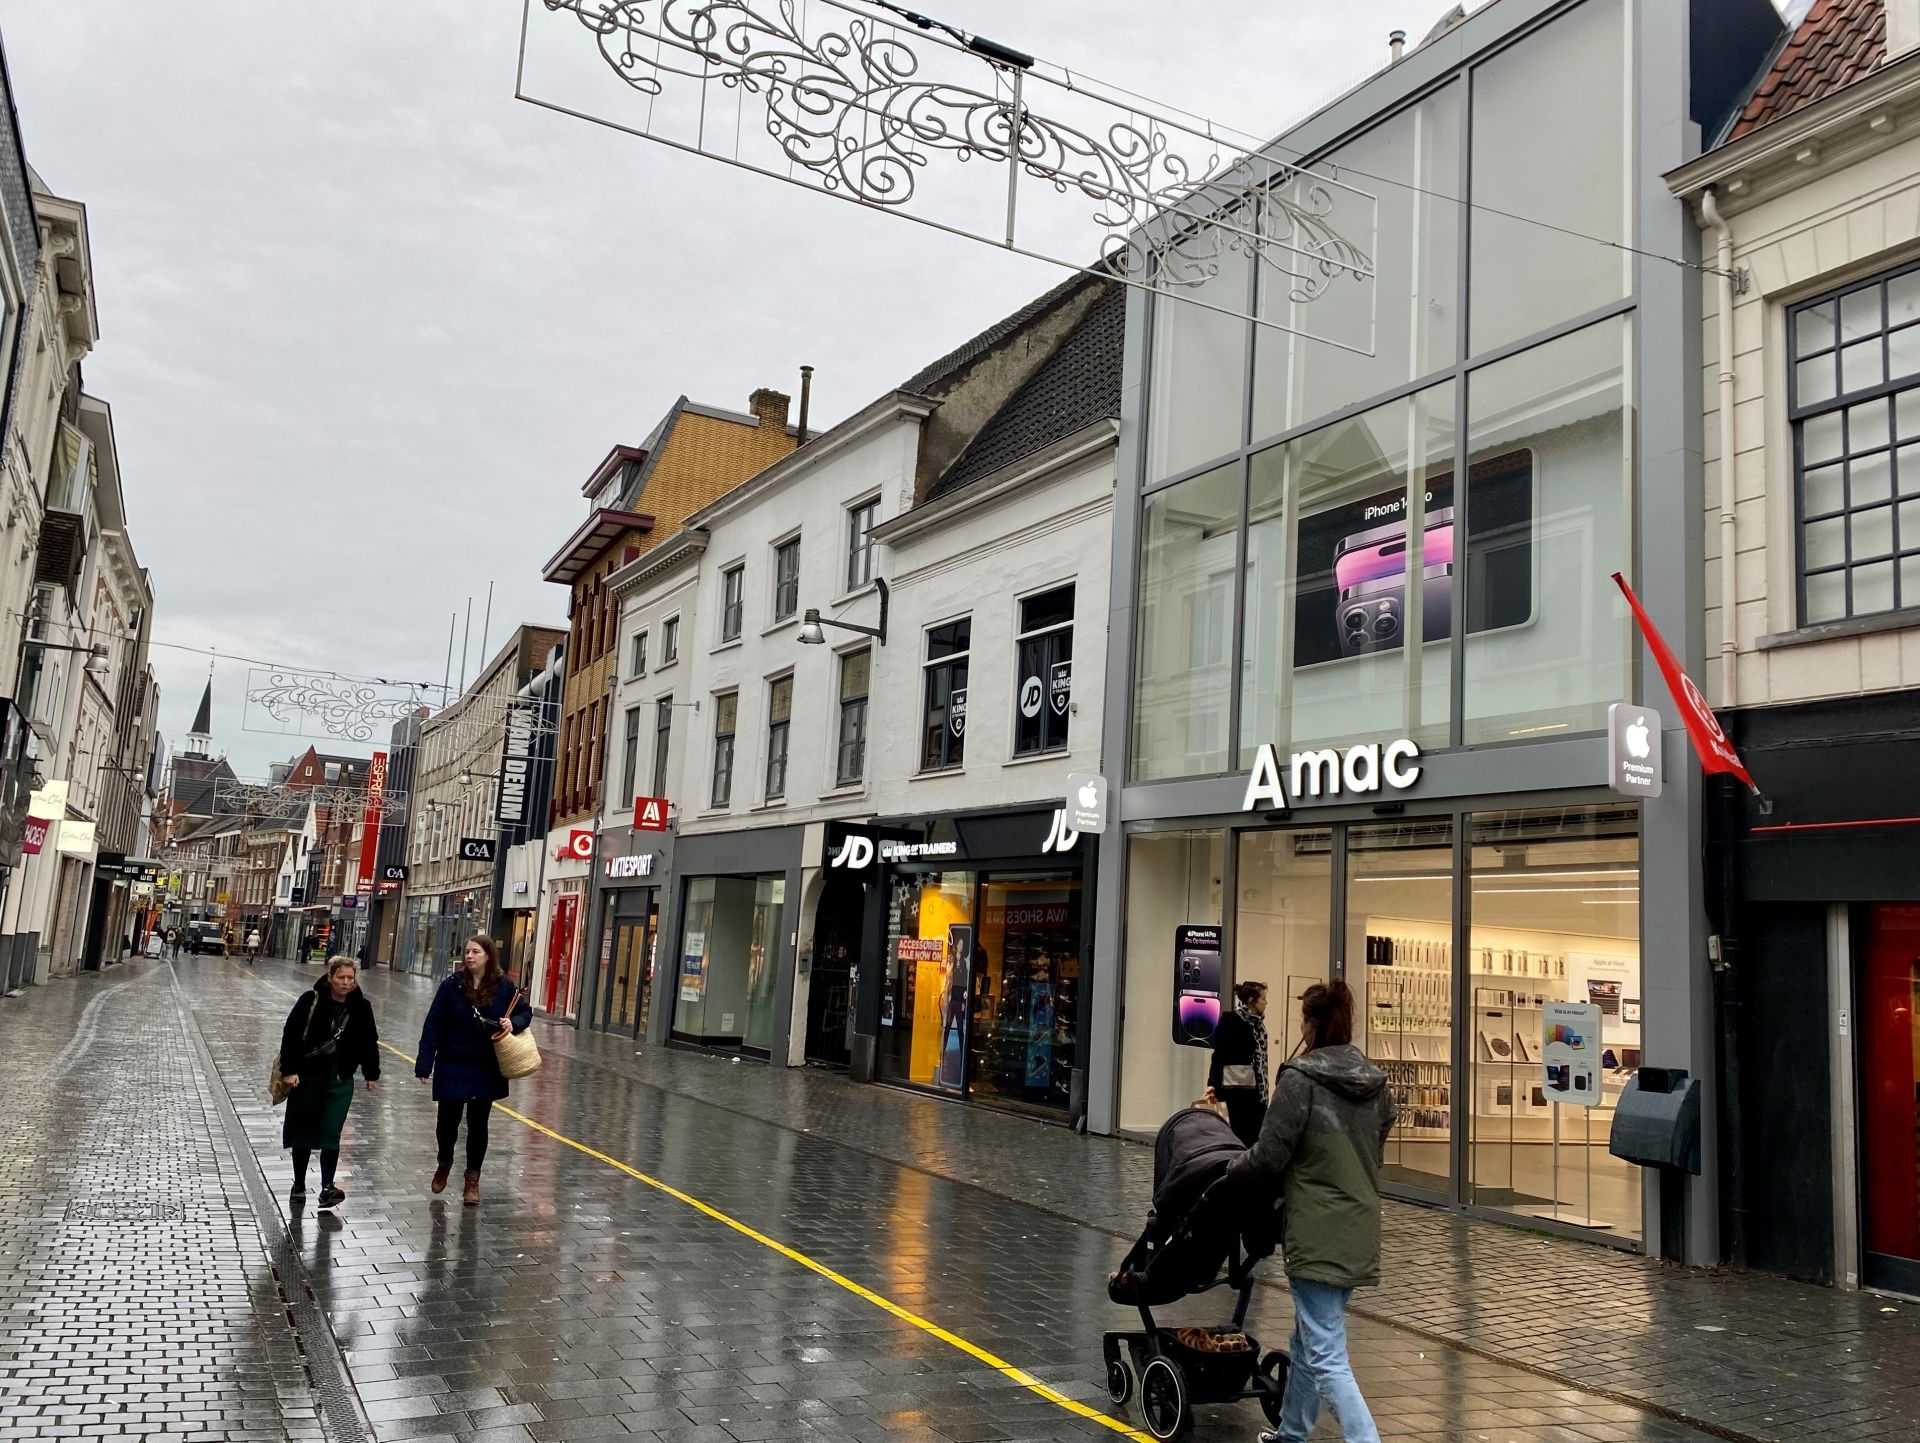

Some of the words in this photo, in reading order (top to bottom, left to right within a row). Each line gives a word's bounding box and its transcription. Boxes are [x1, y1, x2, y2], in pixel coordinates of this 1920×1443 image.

[1364, 500, 1400, 520] iPhone
[1052, 677, 1070, 689] KING
[1024, 685, 1041, 708] JD
[1242, 738, 1421, 811] Amac
[1623, 761, 1654, 774] Premium
[370, 757, 386, 797] ESPRIT
[1626, 774, 1652, 786] Partner
[500, 759, 527, 820] DENIM
[1075, 809, 1100, 819] Premium
[1077, 817, 1097, 826] Partner
[1041, 808, 1079, 853] JD
[464, 842, 490, 858] C&A
[831, 834, 874, 870] JD
[893, 845, 911, 857] KING
[919, 841, 957, 855] TRAINERS
[611, 854, 653, 878] AKTIESPORT
[898, 939, 943, 951] ACCESSORIES
[897, 949, 915, 960] SALE
[914, 950, 931, 961] NOW
[931, 951, 942, 961] ON
